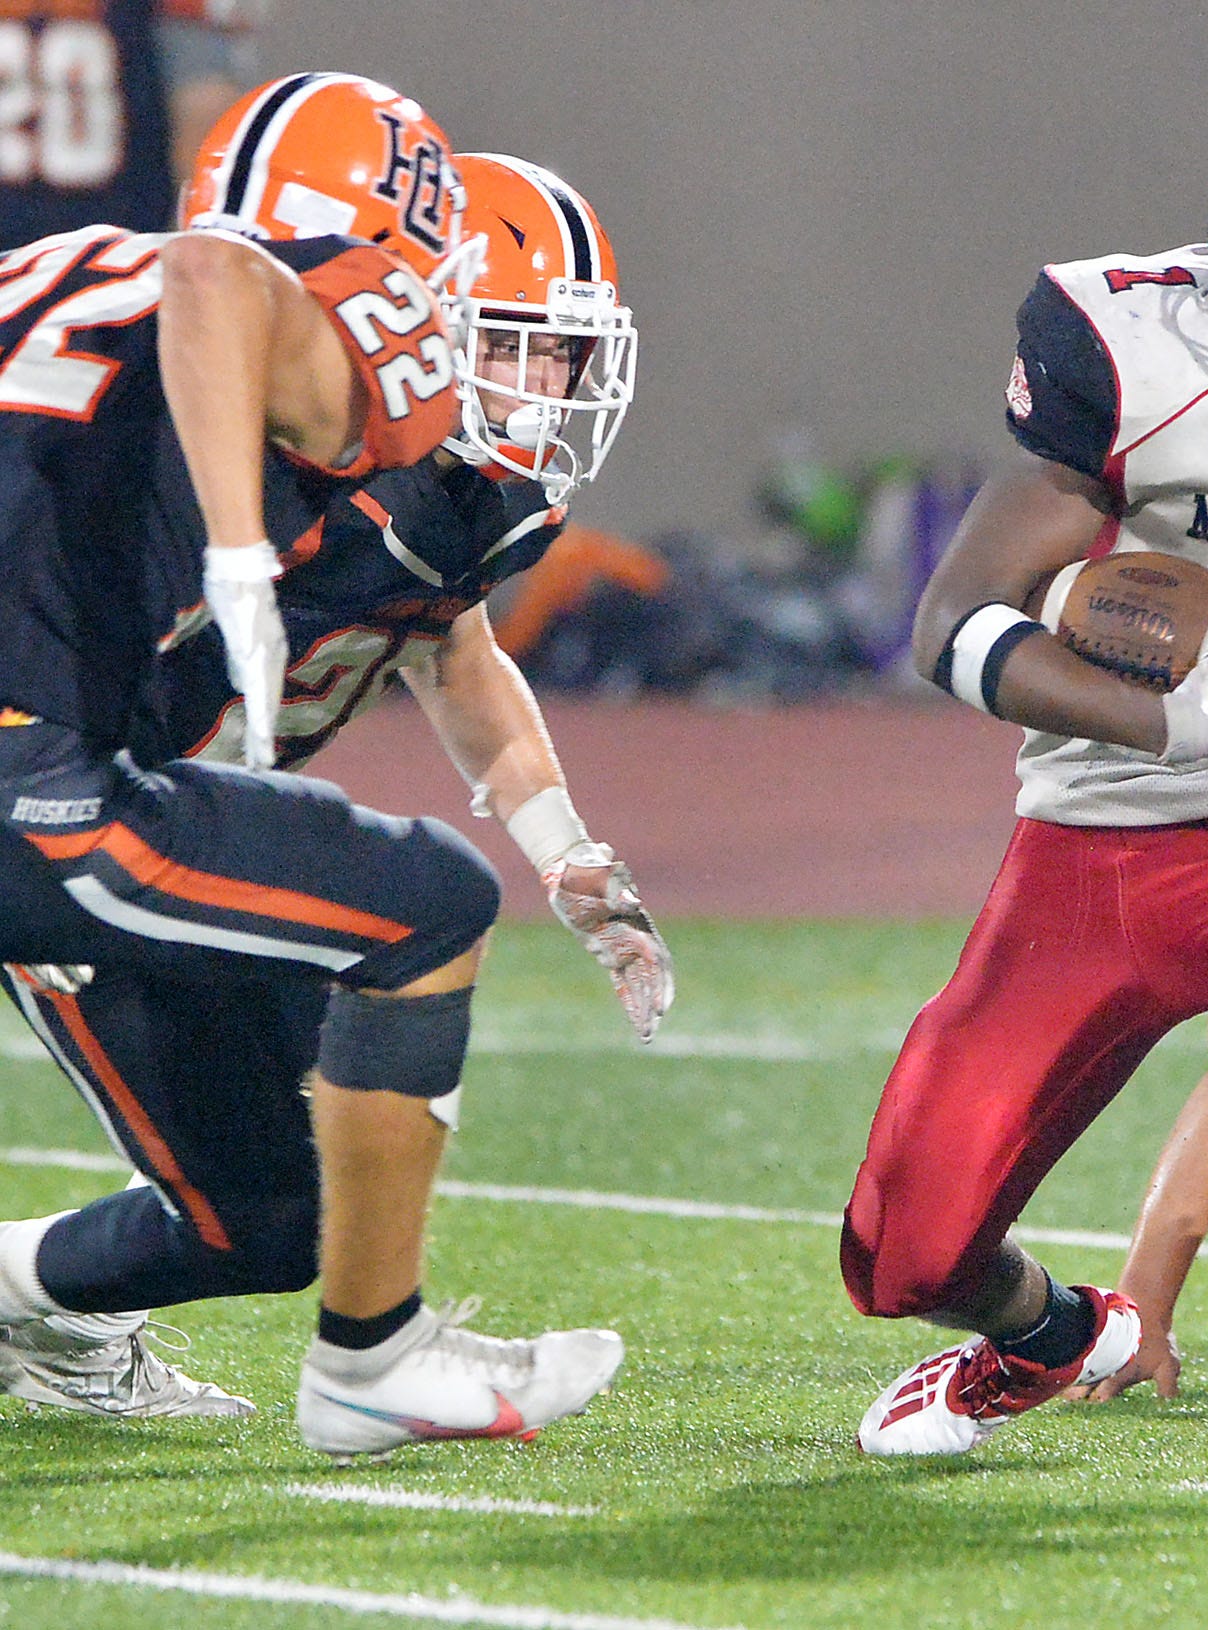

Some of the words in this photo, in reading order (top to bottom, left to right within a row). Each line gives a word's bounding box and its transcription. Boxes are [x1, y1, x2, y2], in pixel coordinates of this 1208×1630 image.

[1103, 265, 1199, 294] 1
[333, 268, 454, 421] 22
[10, 796, 104, 825] HUSKIES
